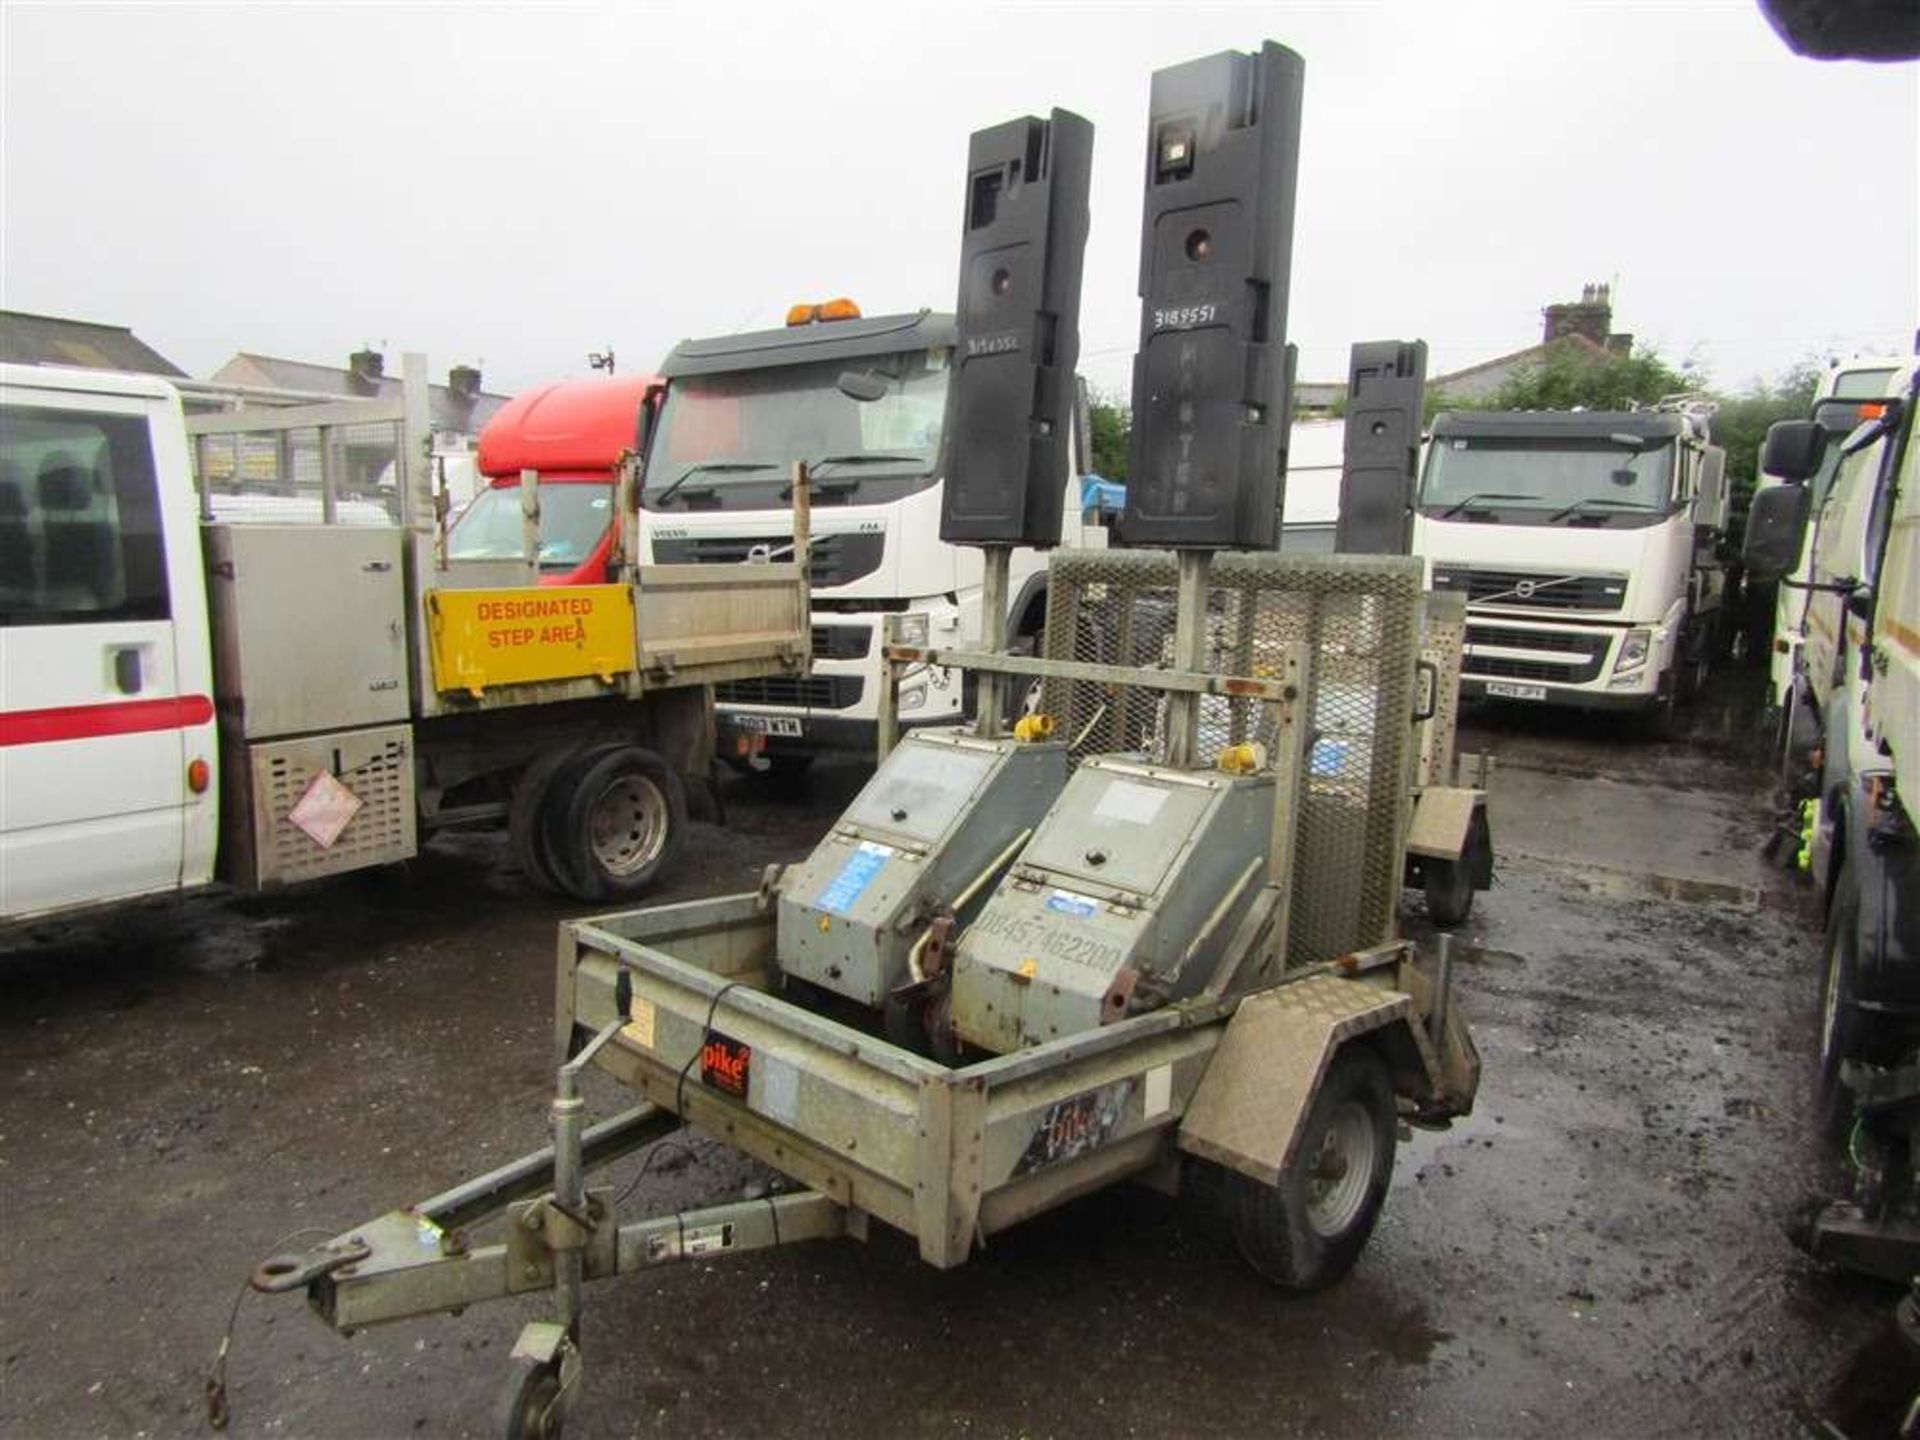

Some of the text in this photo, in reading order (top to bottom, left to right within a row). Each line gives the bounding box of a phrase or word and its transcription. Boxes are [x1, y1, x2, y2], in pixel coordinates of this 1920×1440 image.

[477, 598, 593, 621] DESIGNATED
[488, 625, 585, 648] STEP AREA
